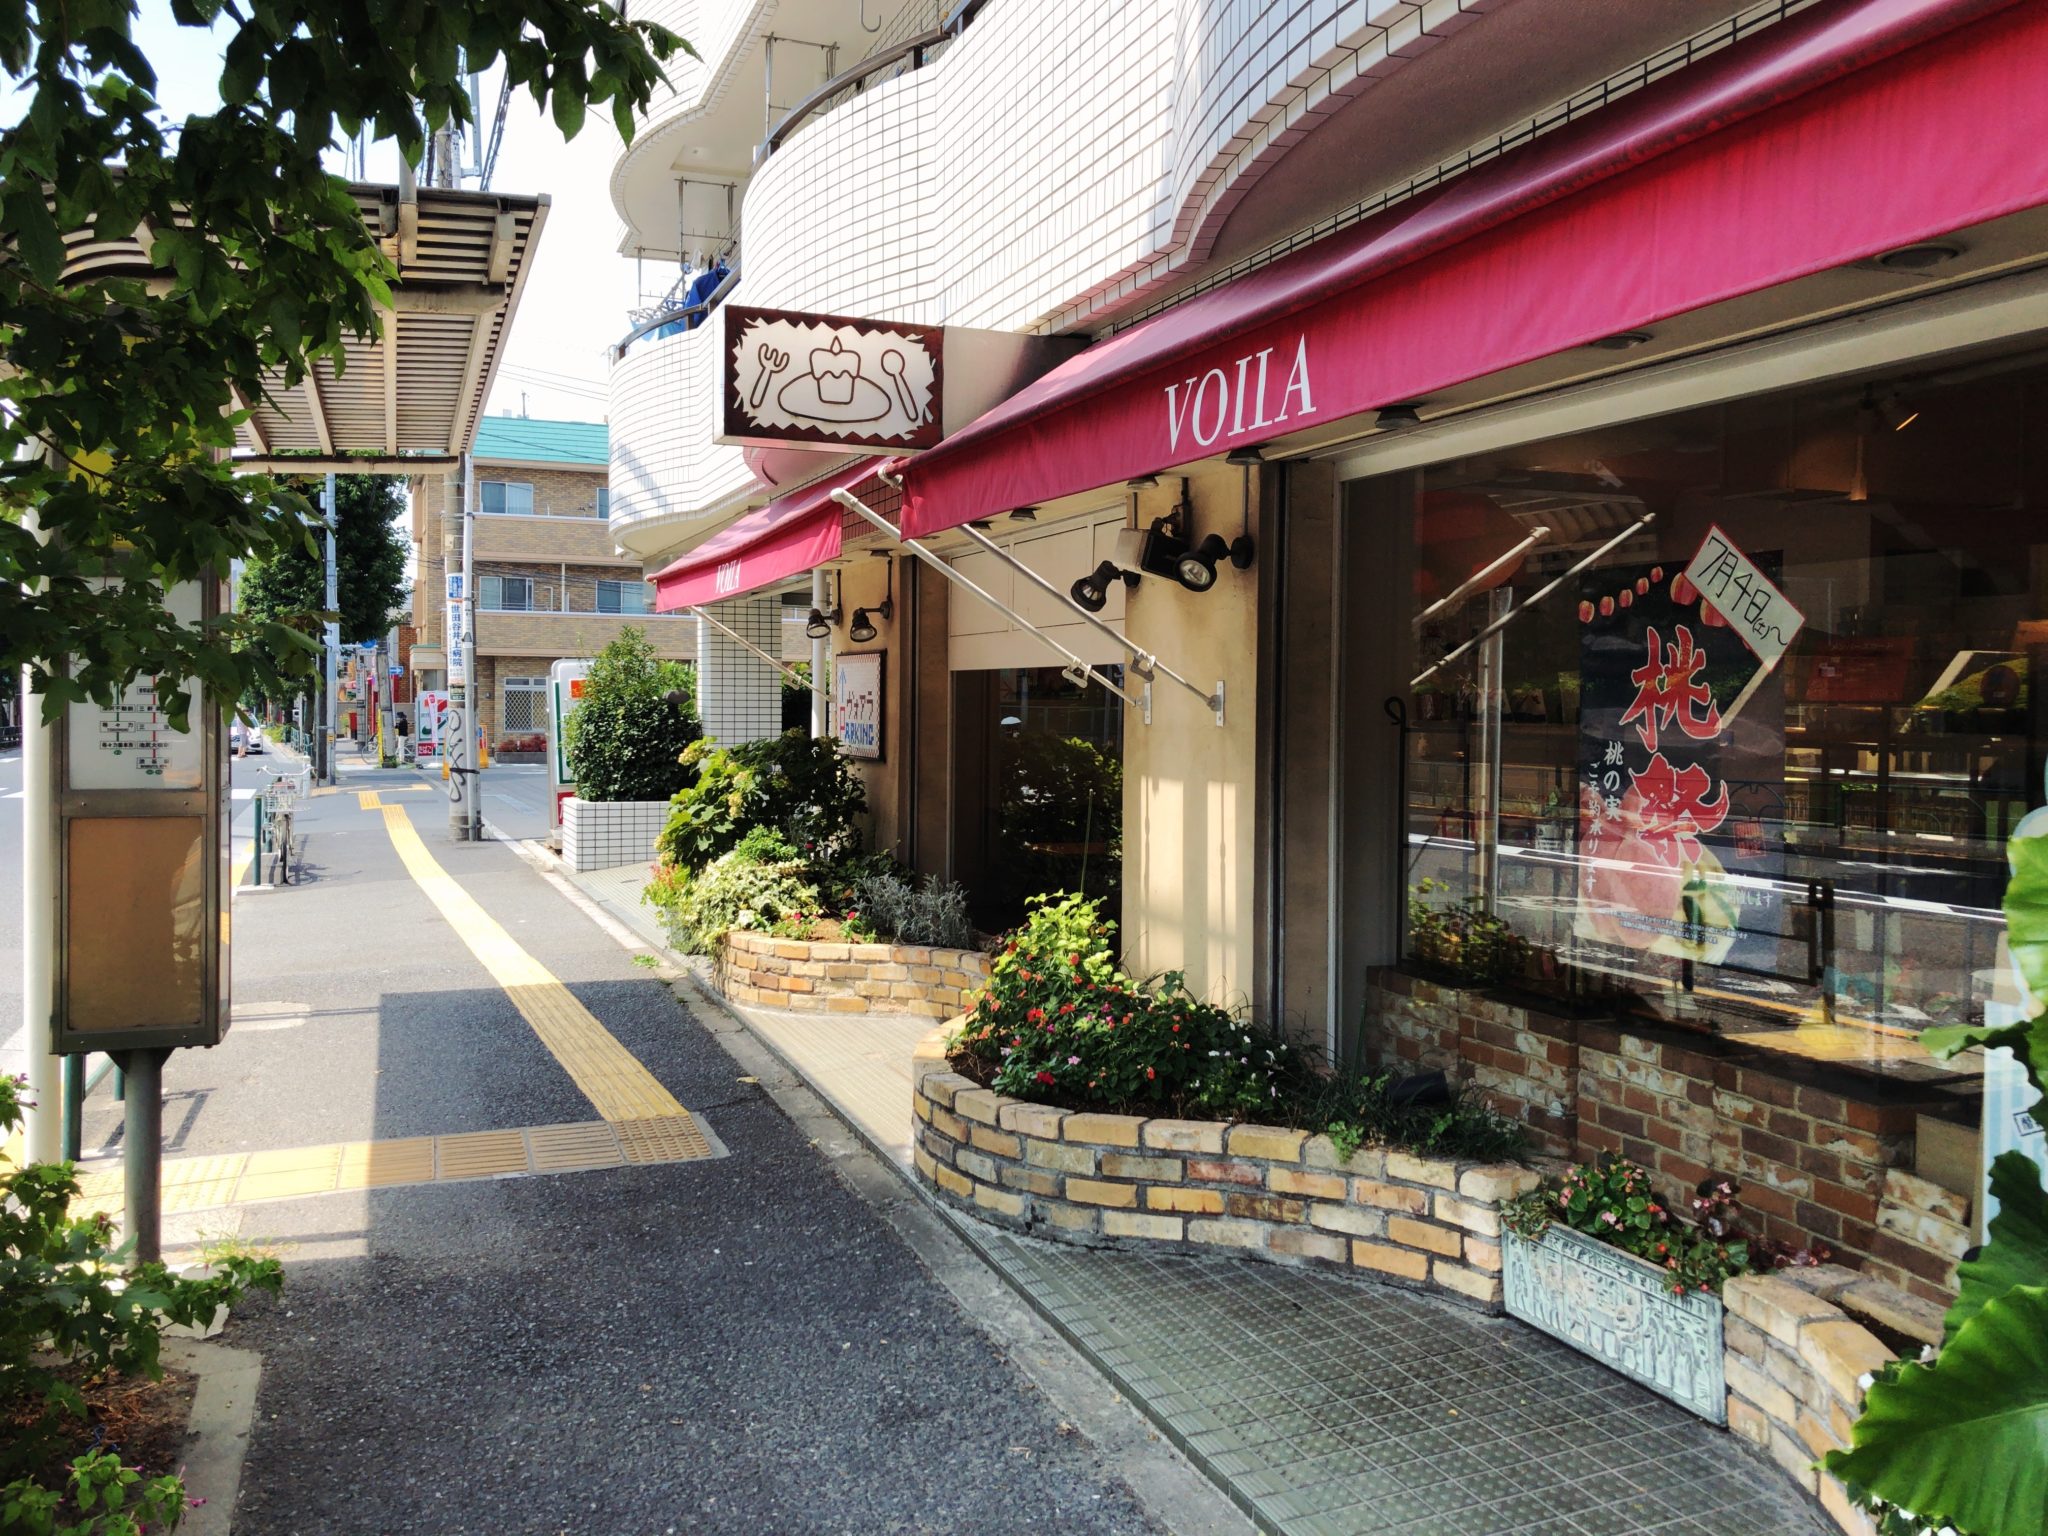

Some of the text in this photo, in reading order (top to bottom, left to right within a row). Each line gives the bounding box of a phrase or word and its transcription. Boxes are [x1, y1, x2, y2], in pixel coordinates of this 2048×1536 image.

[1164, 332, 1317, 455] VOILA
[715, 557, 743, 594] VOILA
[452, 604, 464, 667] 世田谷井上病院
[1604, 740, 1624, 822] 桃の実
